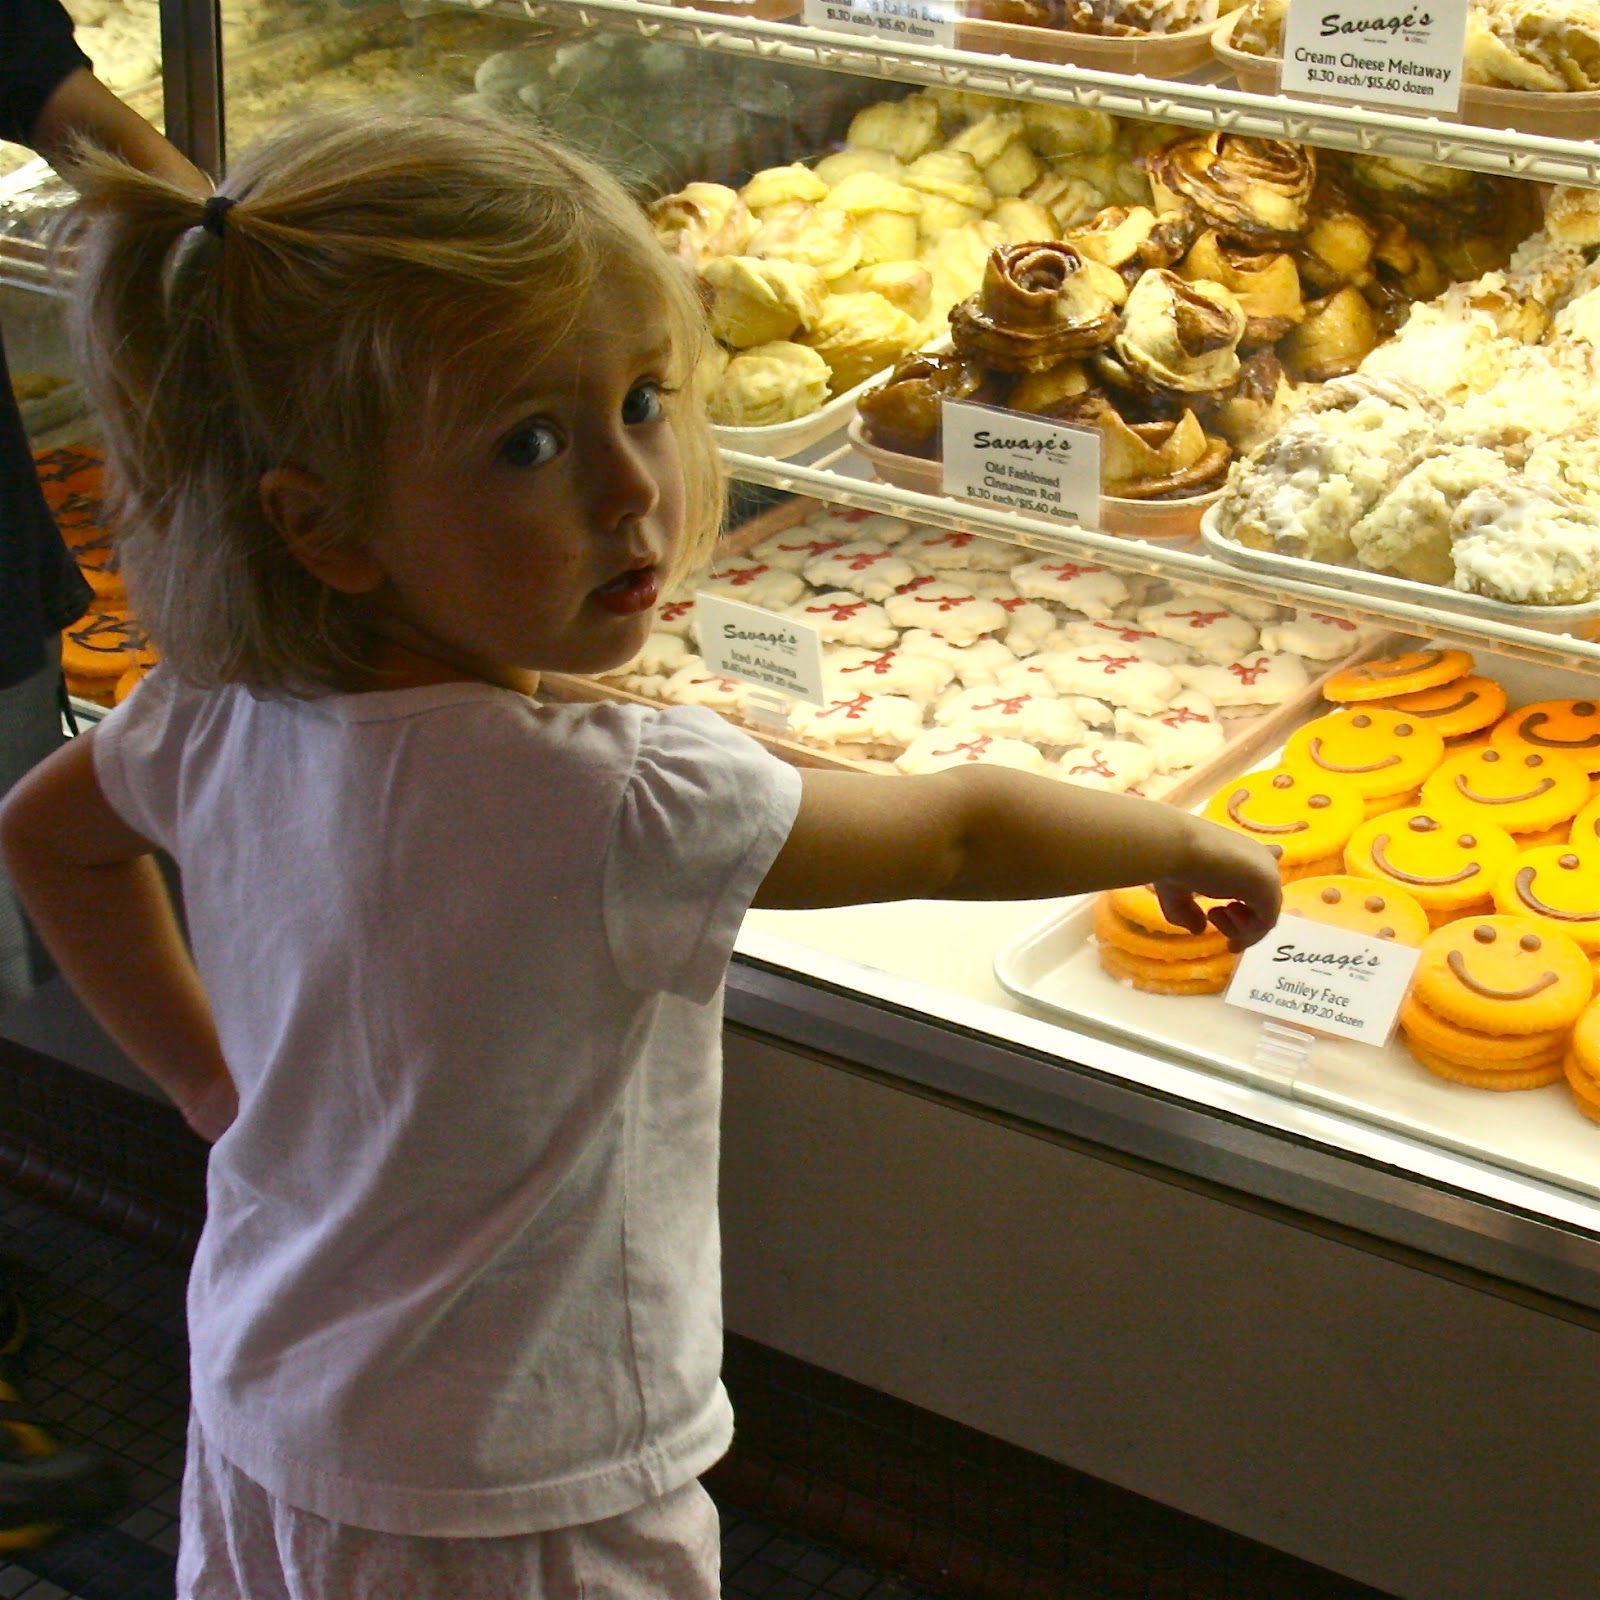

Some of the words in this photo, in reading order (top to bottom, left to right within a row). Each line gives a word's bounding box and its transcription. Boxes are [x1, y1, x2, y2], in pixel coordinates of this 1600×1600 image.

[1320, 6, 1434, 36] Savage's
[1294, 47, 1336, 65] Cream
[1340, 53, 1385, 72] Cheese
[1388, 59, 1451, 83] Meltaway
[1307, 68, 1334, 83] $1.30
[1337, 74, 1400, 91] each/$15.60
[1403, 81, 1434, 95] dozen
[973, 431, 1072, 453] Savage's
[985, 461, 1005, 475] Old
[1008, 466, 1060, 489] Fashioned
[984, 476, 1037, 498] Cinnamon
[1040, 488, 1061, 503] Roll
[1051, 506, 1078, 520] dozen
[723, 624, 798, 646] Savage's
[1272, 945, 1381, 969] Savage's
[1275, 976, 1319, 1001] Smiley
[1321, 988, 1350, 1007] Face
[1249, 989, 1274, 1003] $1.60
[1334, 1009, 1364, 1028] dozen
